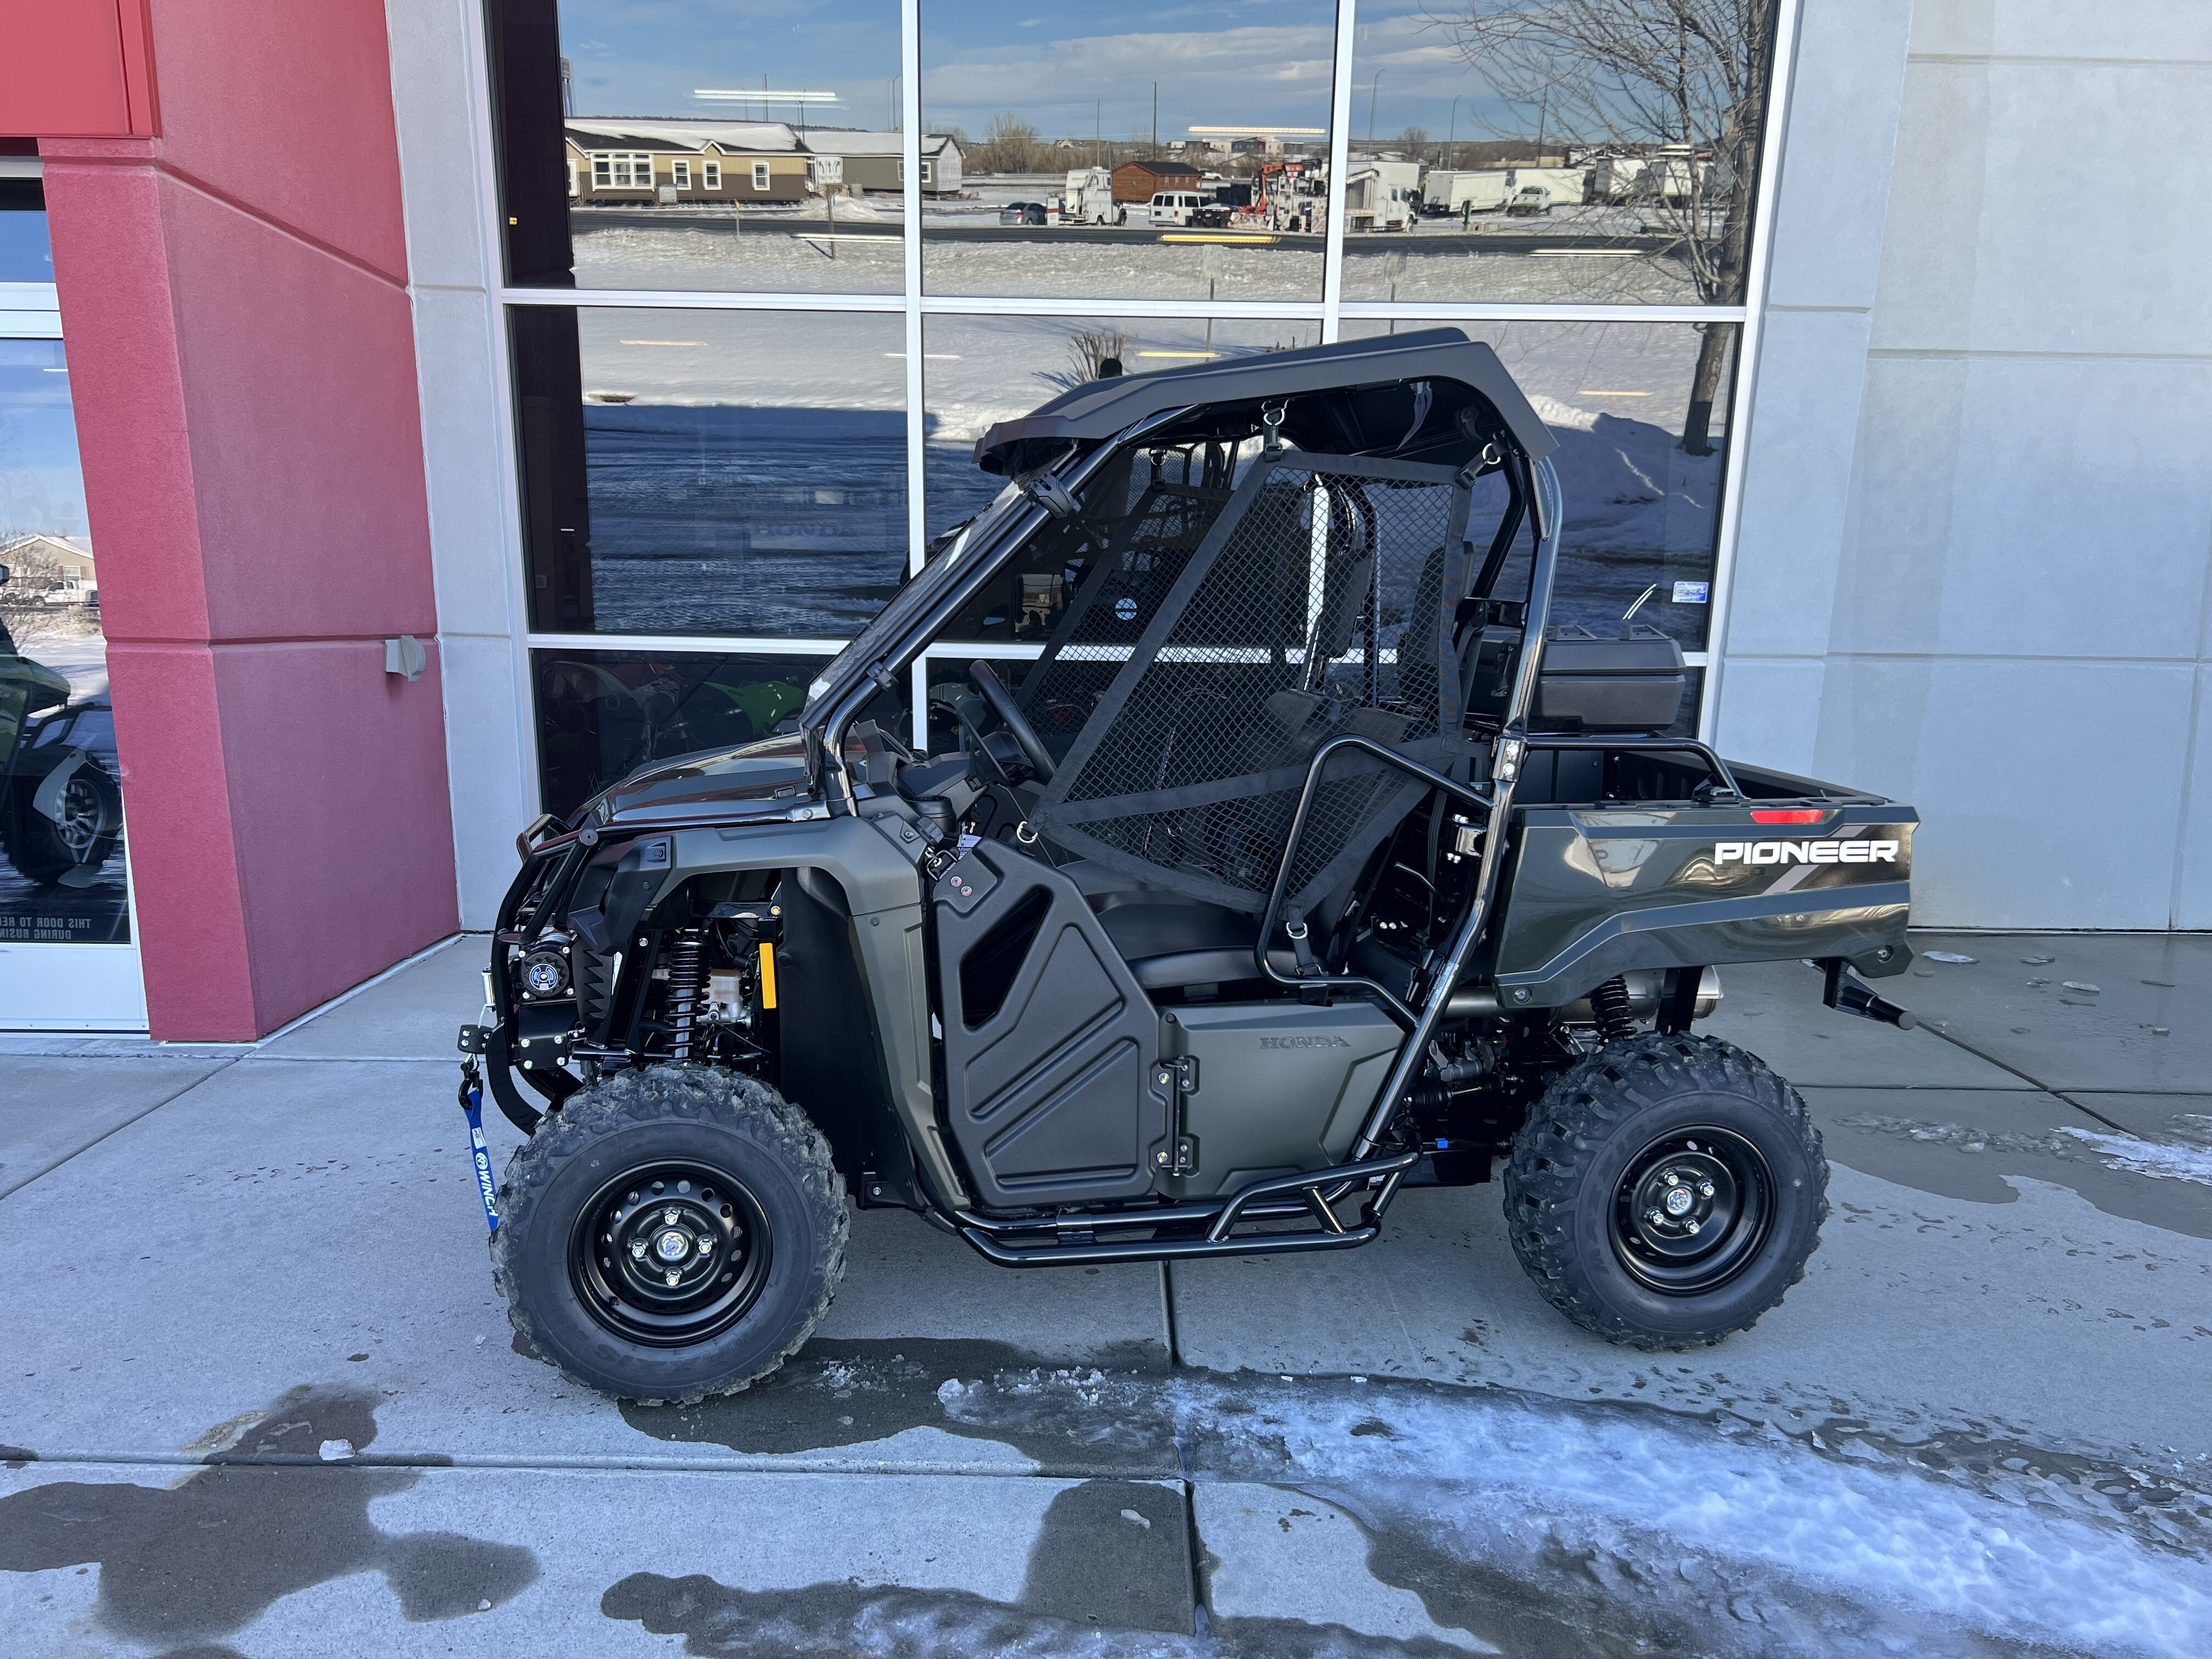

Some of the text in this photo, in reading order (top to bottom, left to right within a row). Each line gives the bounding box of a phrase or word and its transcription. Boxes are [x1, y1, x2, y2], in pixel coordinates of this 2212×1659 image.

[1714, 840, 1899, 865] PIONEER
[1260, 1035, 1351, 1049] HONDA
[478, 1170, 499, 1217] WINCH
[1586, 1123, 1646, 1274] MAXXIS
[593, 1323, 759, 1375] MAXXIS
